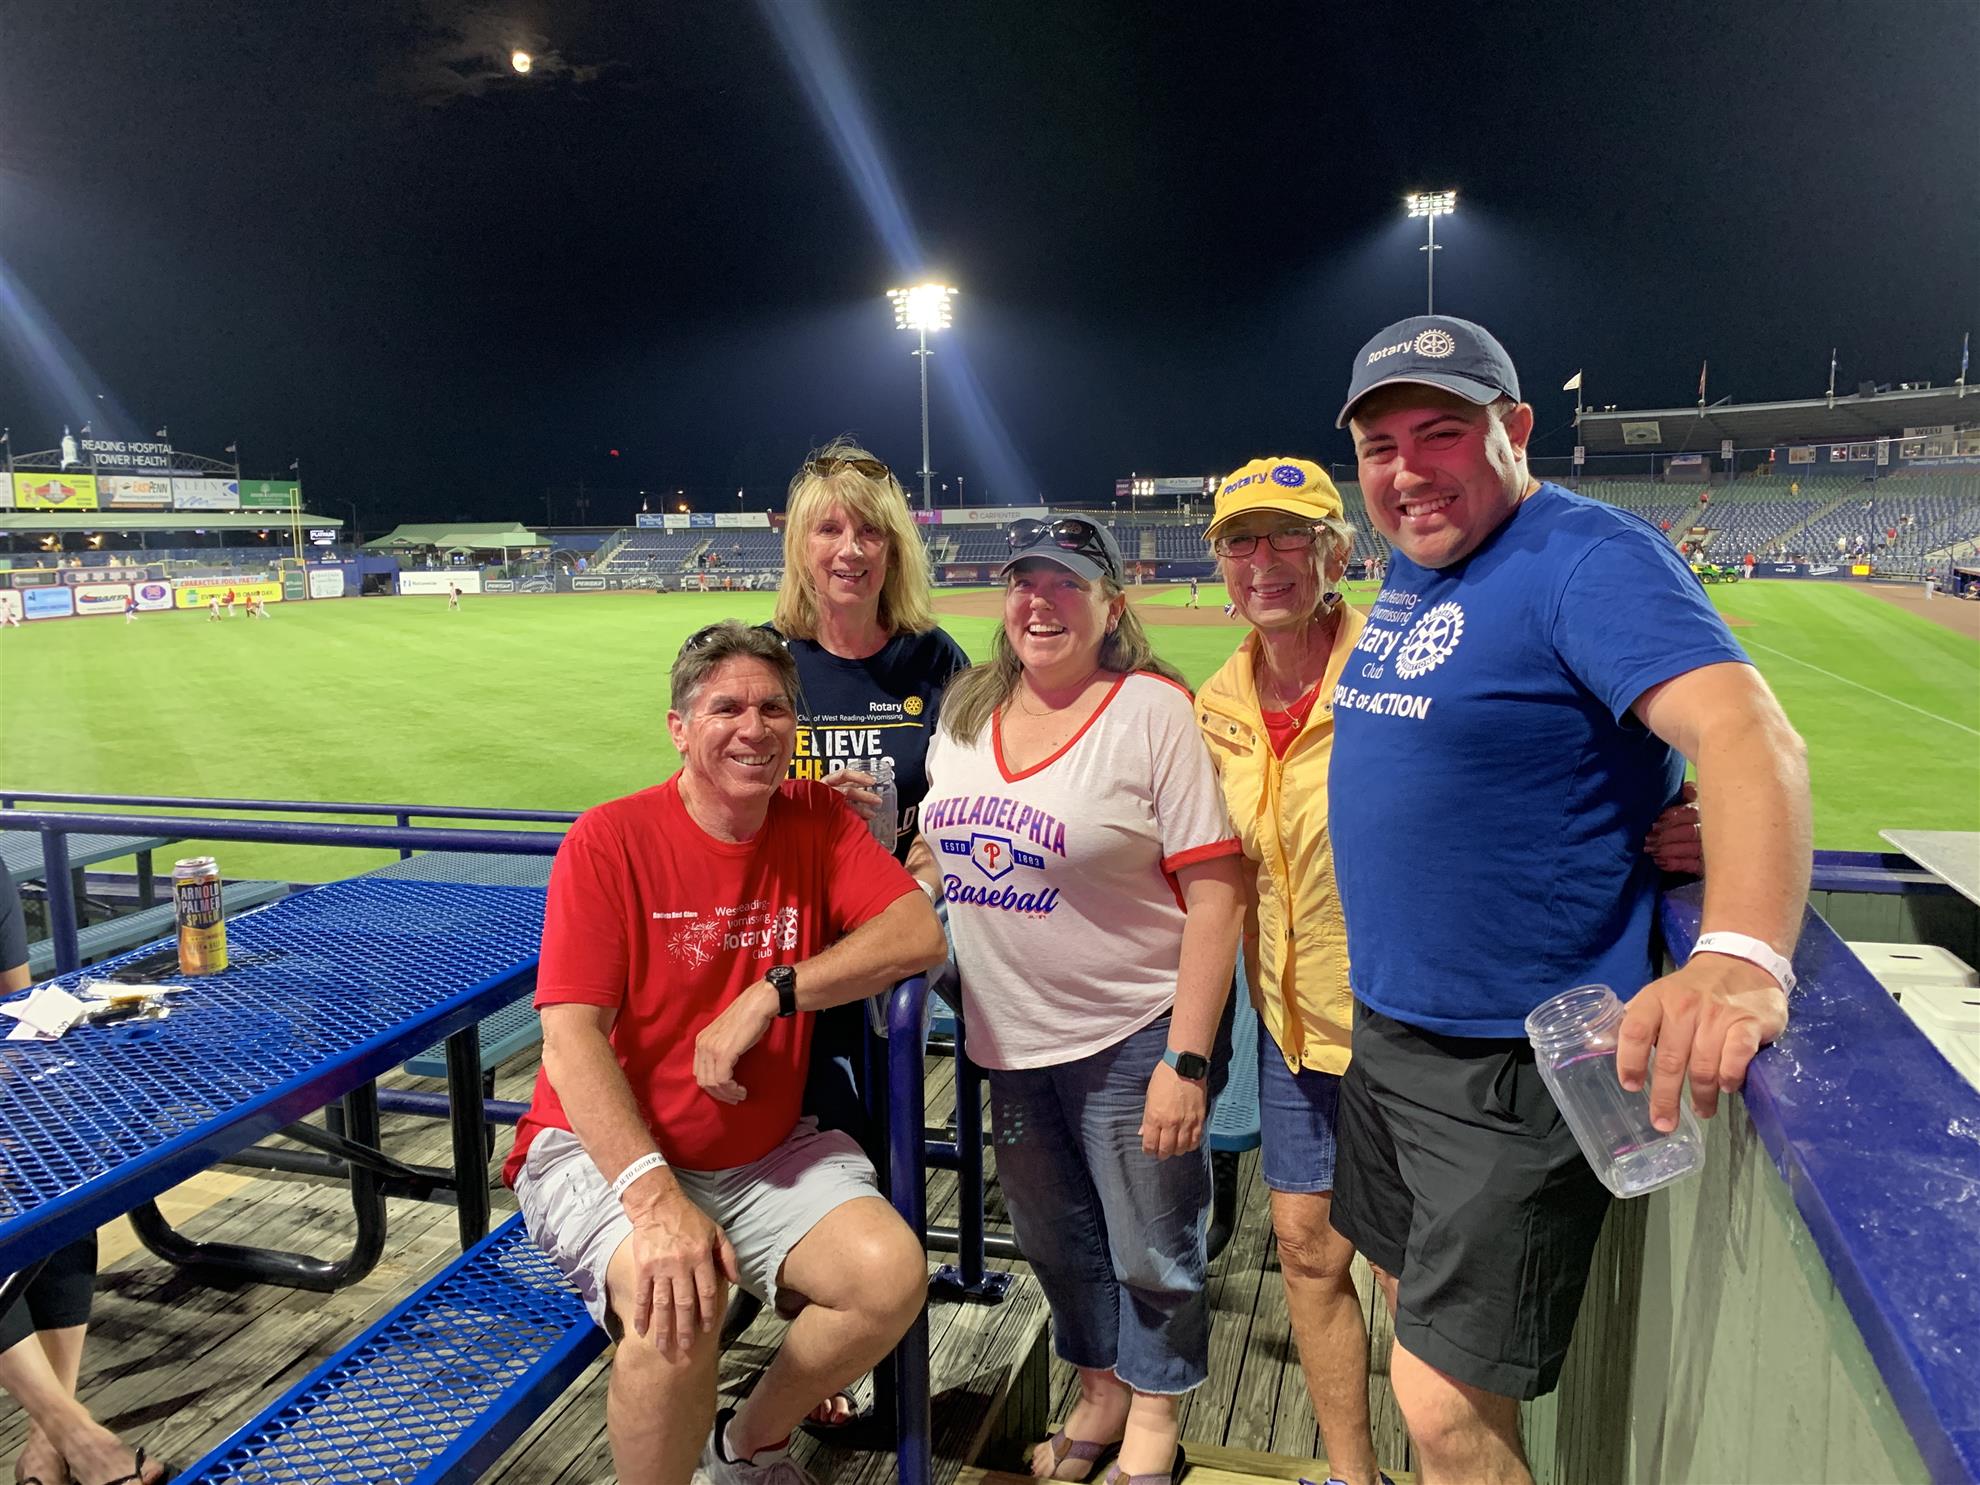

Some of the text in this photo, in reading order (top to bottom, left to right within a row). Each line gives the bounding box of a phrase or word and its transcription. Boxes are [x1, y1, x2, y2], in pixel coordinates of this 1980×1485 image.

[1366, 338, 1413, 366] Rotary
[81, 439, 175, 455] READING HOSPITAL
[93, 453, 167, 466] TOWER HEALTH
[174, 481, 218, 491] KLEIN
[1222, 471, 1267, 497] Rotary
[980, 511, 1021, 519] CARPENTER
[1361, 662, 1384, 679] Club
[869, 701, 902, 713] Rotary
[1355, 694, 1370, 710] OF
[1366, 692, 1432, 720] ACTION
[813, 714, 821, 722] of
[839, 713, 903, 722] Reading-Wyomissing
[795, 729, 882, 757] ELIEVE
[924, 795, 1067, 859] PHILADELPHIA
[944, 842, 966, 852] ESTD
[1017, 853, 1040, 867] 1883
[181, 883, 219, 900] ARNOLD
[943, 873, 1060, 914] Baseball
[181, 896, 221, 913] PALMER
[723, 928, 772, 951] Rotary
[752, 947, 773, 960] Club
